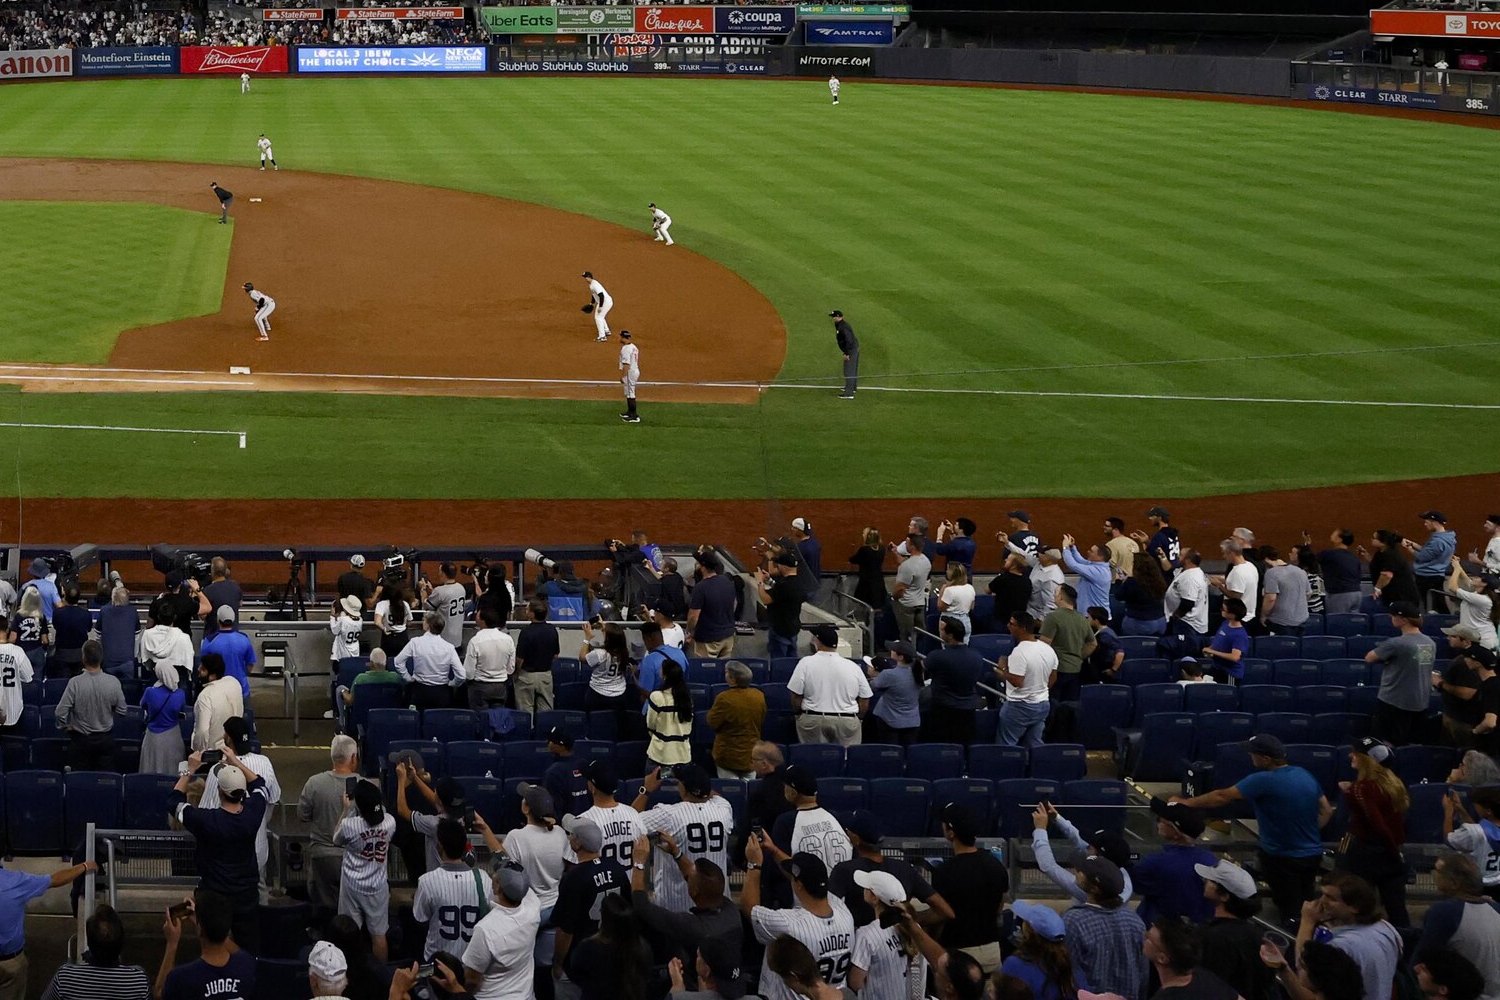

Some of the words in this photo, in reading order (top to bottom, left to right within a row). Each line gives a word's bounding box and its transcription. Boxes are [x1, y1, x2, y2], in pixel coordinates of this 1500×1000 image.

[520, 15, 553, 26] Eats
[745, 11, 782, 24] coupa
[81, 52, 132, 64] Montefiore
[133, 51, 171, 63] Einstein
[204, 52, 262, 65] Budweiser
[314, 50, 348, 58] LOCAL
[354, 50, 360, 58] 3
[365, 49, 391, 58] IBEW
[445, 48, 483, 56] NECA
[300, 58, 316, 66] THE
[319, 58, 358, 66] RIGHT
[363, 58, 406, 66] CHOICE
[498, 61, 539, 71] StubHub
[542, 61, 583, 71] StubHub
[586, 61, 628, 71] StubHub
[800, 55, 870, 67] NITTOTIRE.COM
[449, 597, 465, 616] 23
[603, 820, 633, 841] JUDGE
[686, 820, 725, 853] 99
[593, 869, 613, 888] COLE
[819, 933, 850, 956] JUDGE
[204, 978, 240, 998] JUDGE
